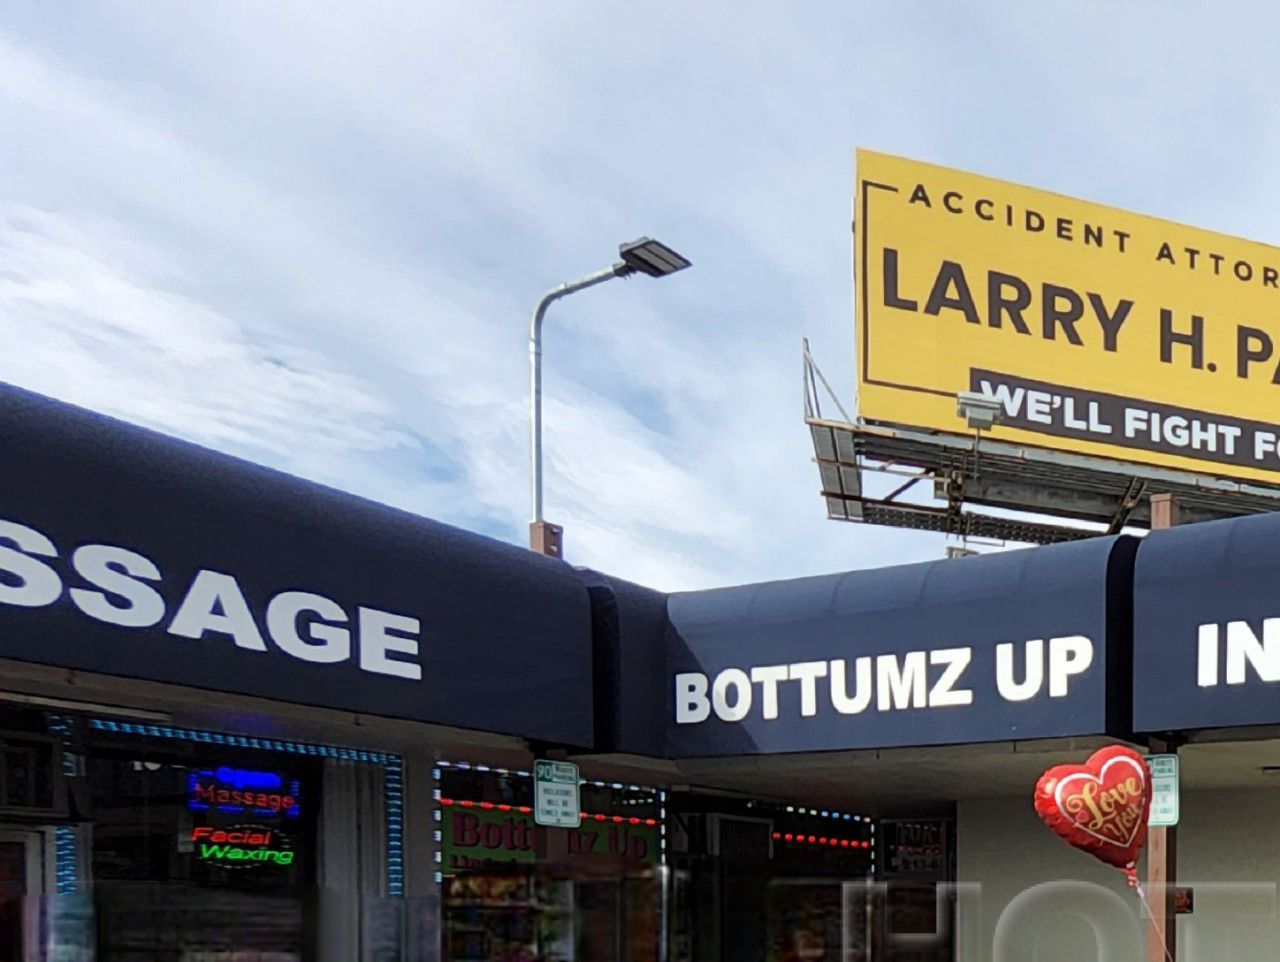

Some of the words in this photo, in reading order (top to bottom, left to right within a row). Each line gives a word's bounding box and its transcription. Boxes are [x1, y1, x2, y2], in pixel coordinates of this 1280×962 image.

[908, 183, 1132, 253] ACCIDENT
[882, 246, 1136, 352] LARRY
[1158, 308, 1217, 373] H.
[979, 379, 1112, 434] WE'LL
[1125, 407, 1241, 455] FIGHT
[675, 647, 973, 724] BOTTUMZ
[995, 635, 1094, 702] UP
[194, 783, 295, 811] Massage
[1066, 777, 1142, 830] Love
[1102, 804, 1141, 841] You
[191, 828, 271, 845] Facial
[200, 844, 294, 865] Waxing
